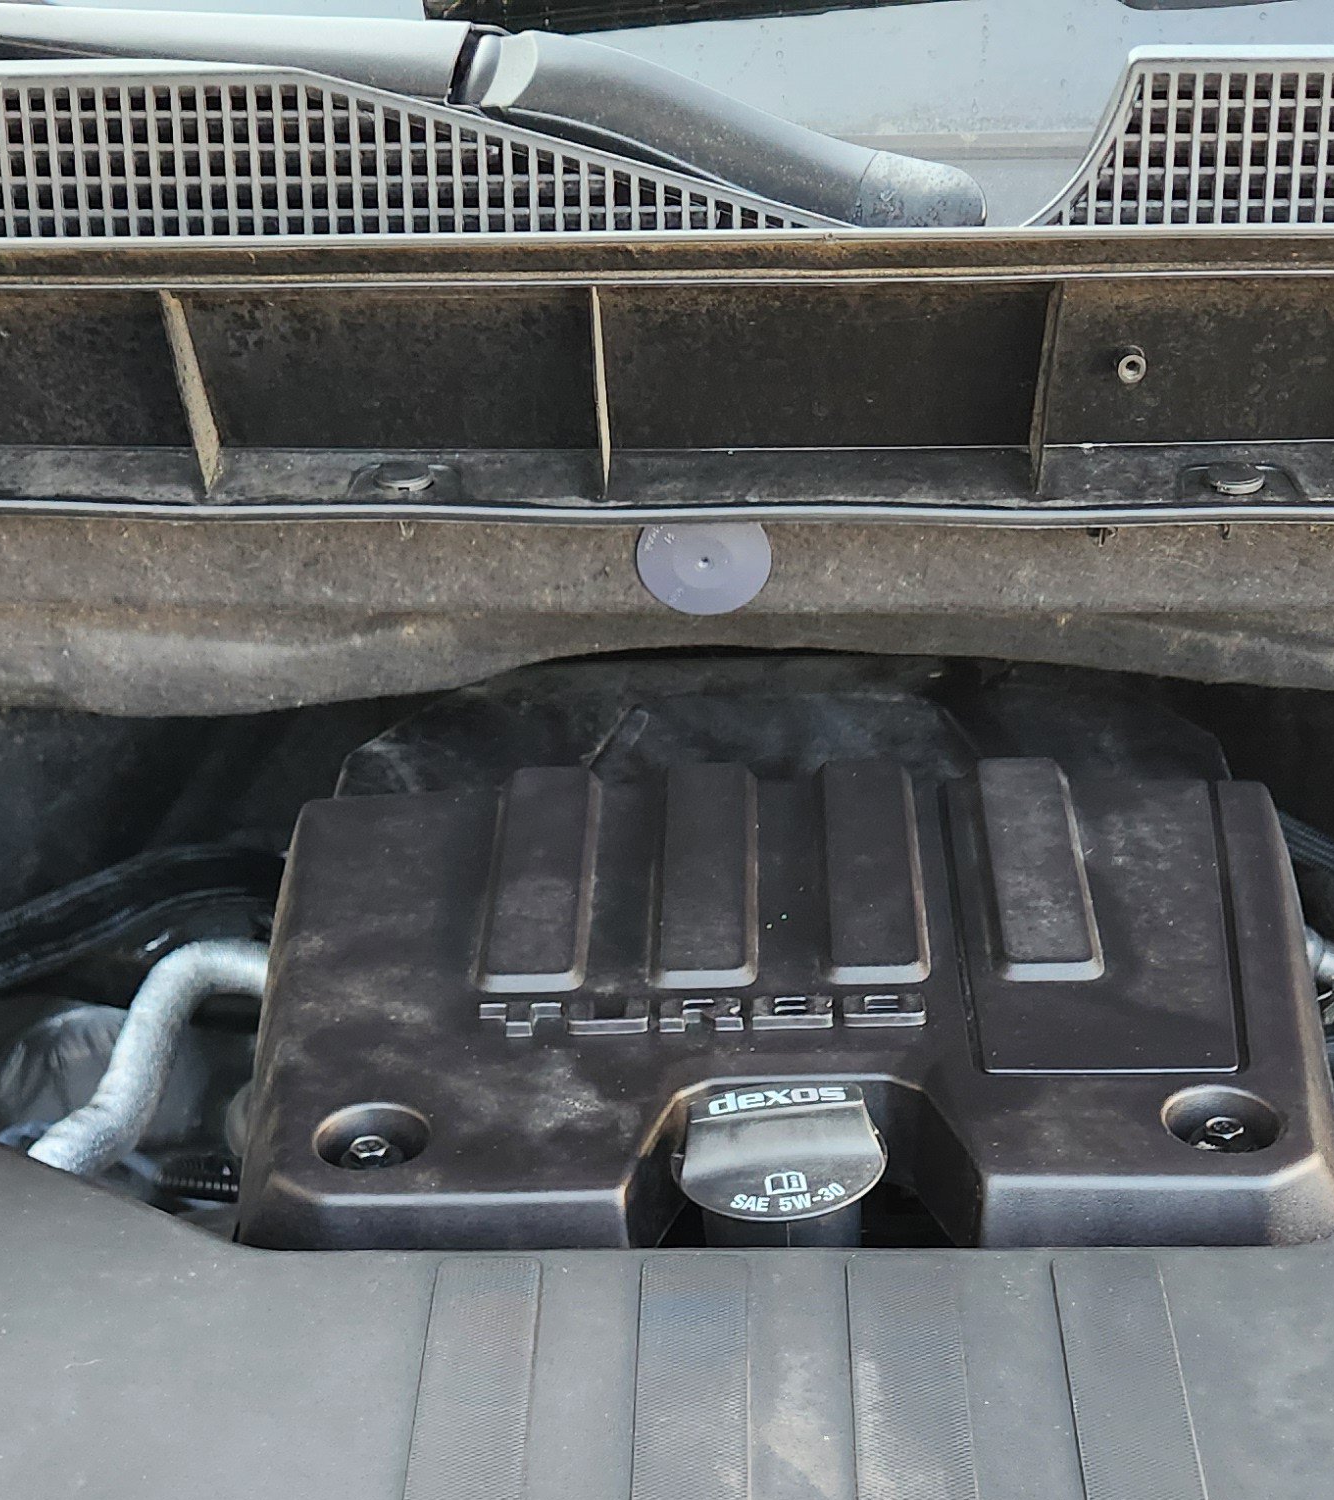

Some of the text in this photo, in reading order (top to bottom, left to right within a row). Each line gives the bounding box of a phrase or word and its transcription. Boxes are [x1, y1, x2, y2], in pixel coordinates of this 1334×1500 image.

[479, 995, 927, 1037] TURBO
[708, 1087, 846, 1115] dexos
[730, 1182, 845, 1212] SAE 5W-30
